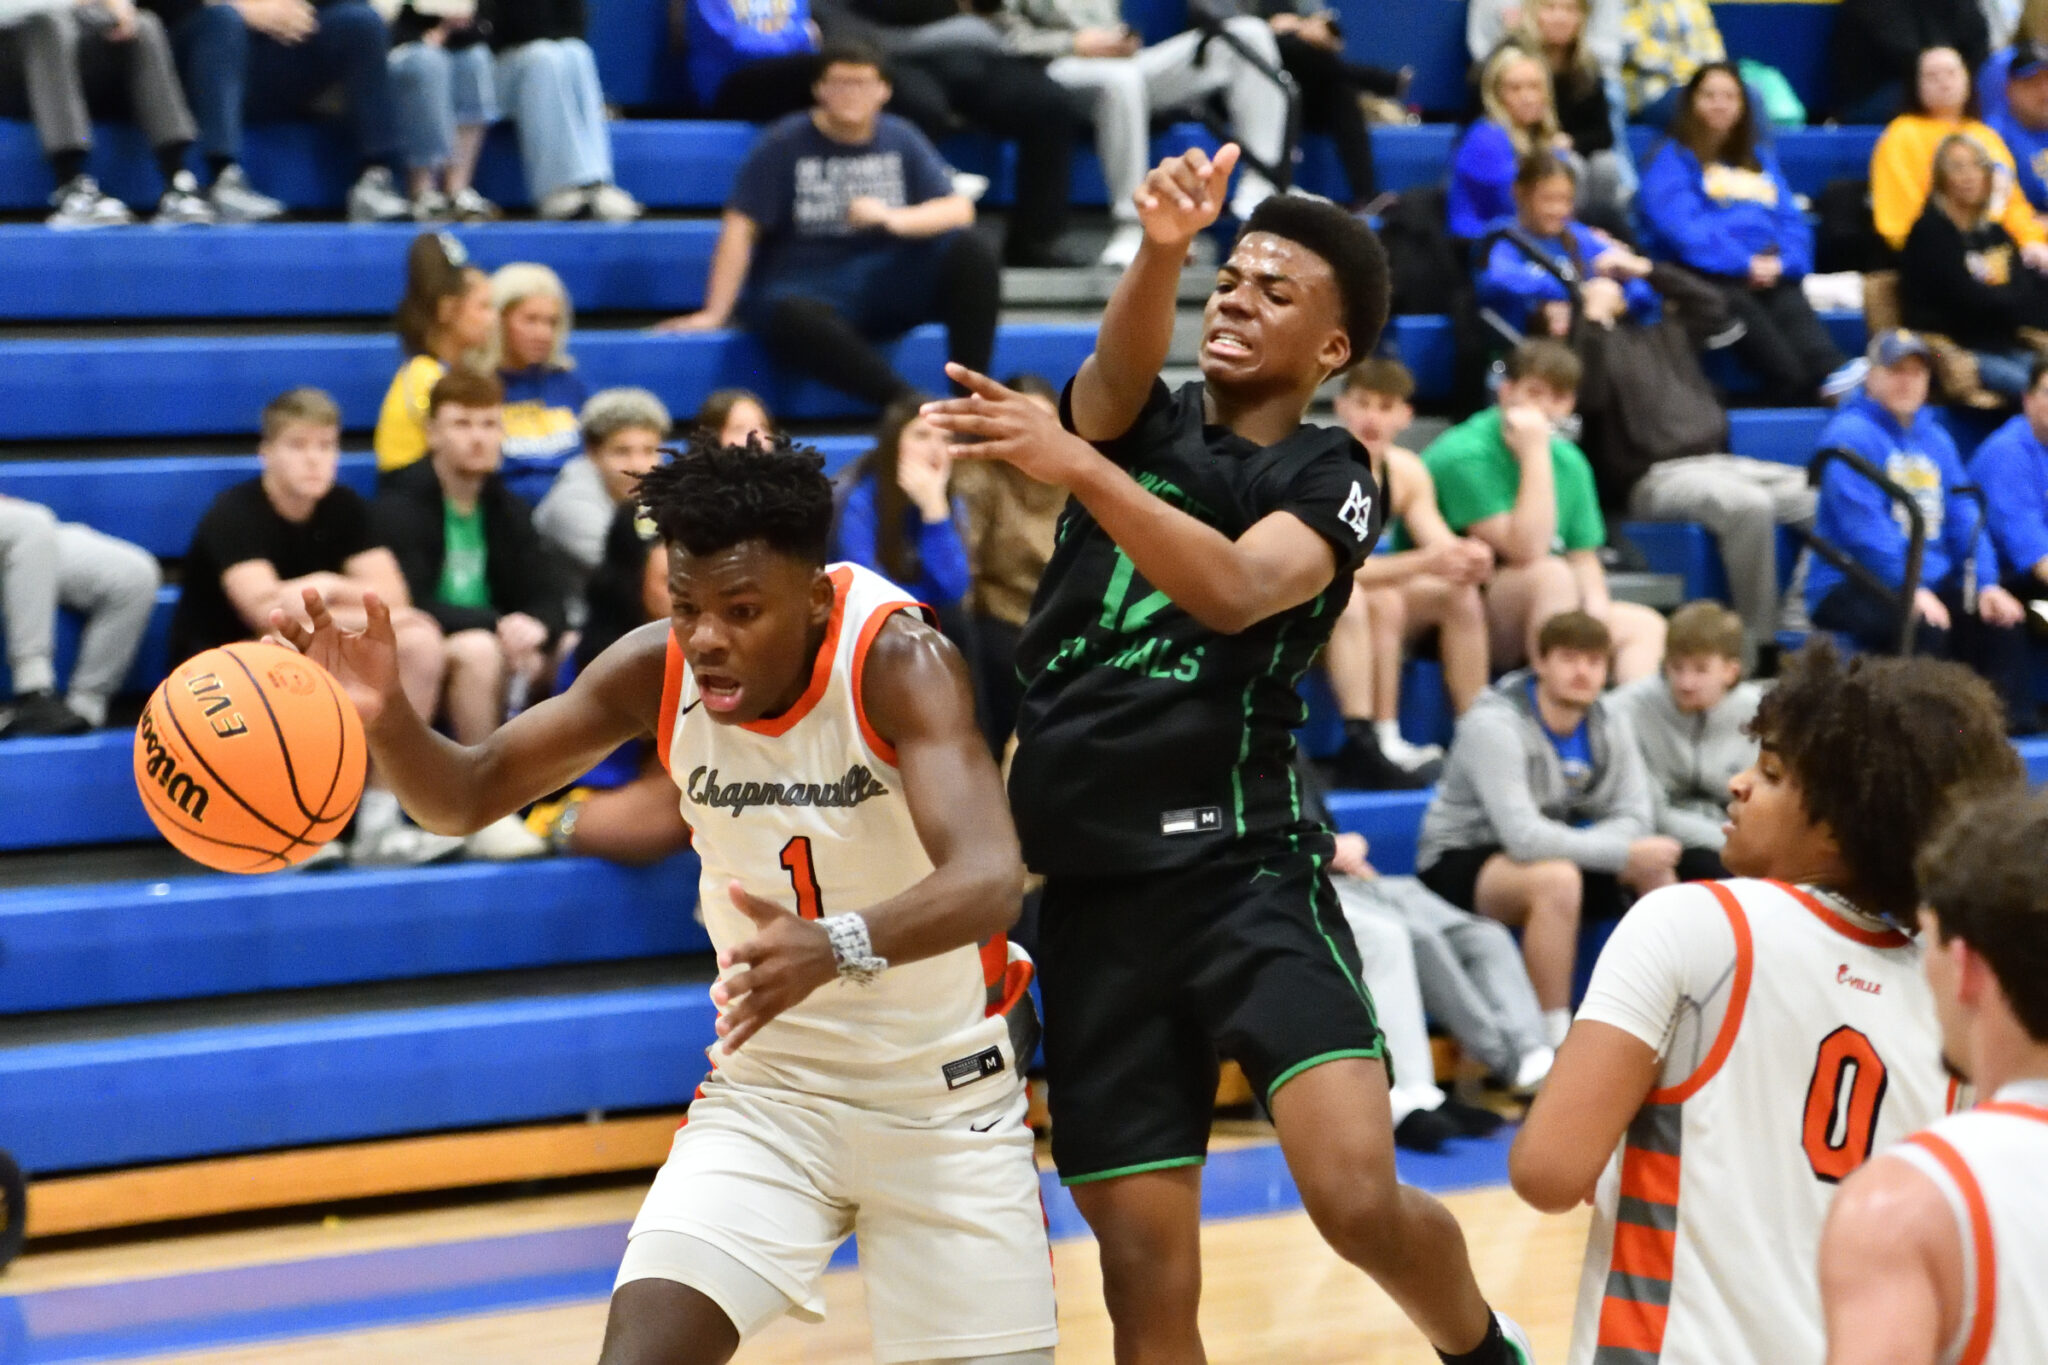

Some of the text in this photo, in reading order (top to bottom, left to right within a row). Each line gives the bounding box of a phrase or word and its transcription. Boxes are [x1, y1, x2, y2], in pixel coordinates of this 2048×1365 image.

[687, 764, 889, 818] Chapmanville
[1202, 811, 1215, 824] M
[779, 836, 825, 921] 1
[985, 1056, 997, 1070] M
